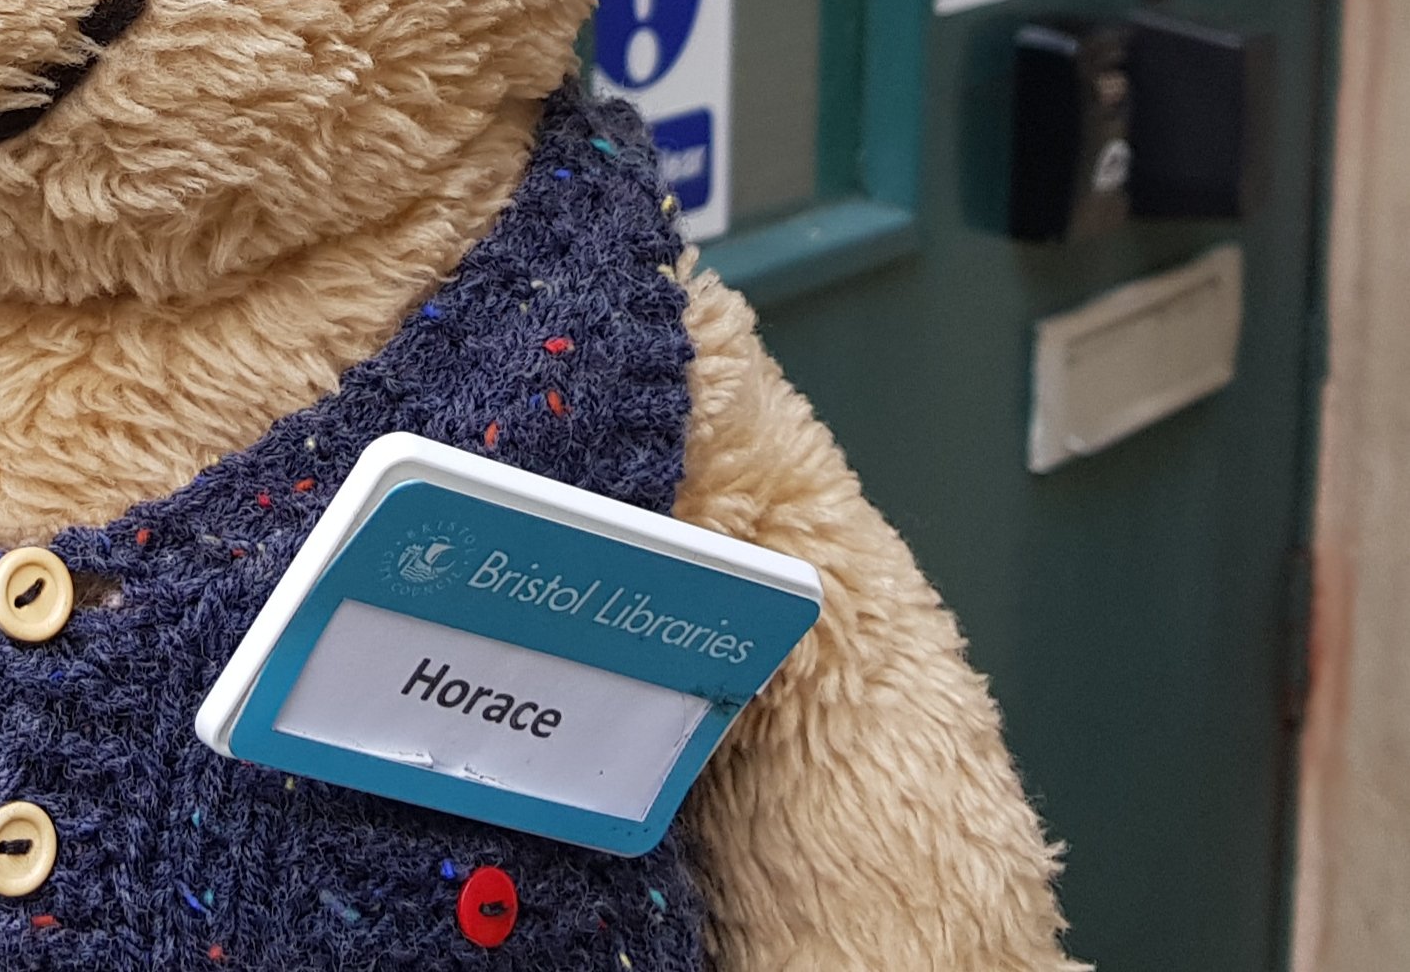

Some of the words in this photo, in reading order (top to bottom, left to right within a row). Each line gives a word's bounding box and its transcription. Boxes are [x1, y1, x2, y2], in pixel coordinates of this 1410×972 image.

[467, 550, 602, 615] Bristol
[593, 586, 755, 665] Libraries
[400, 657, 562, 739] Horace
